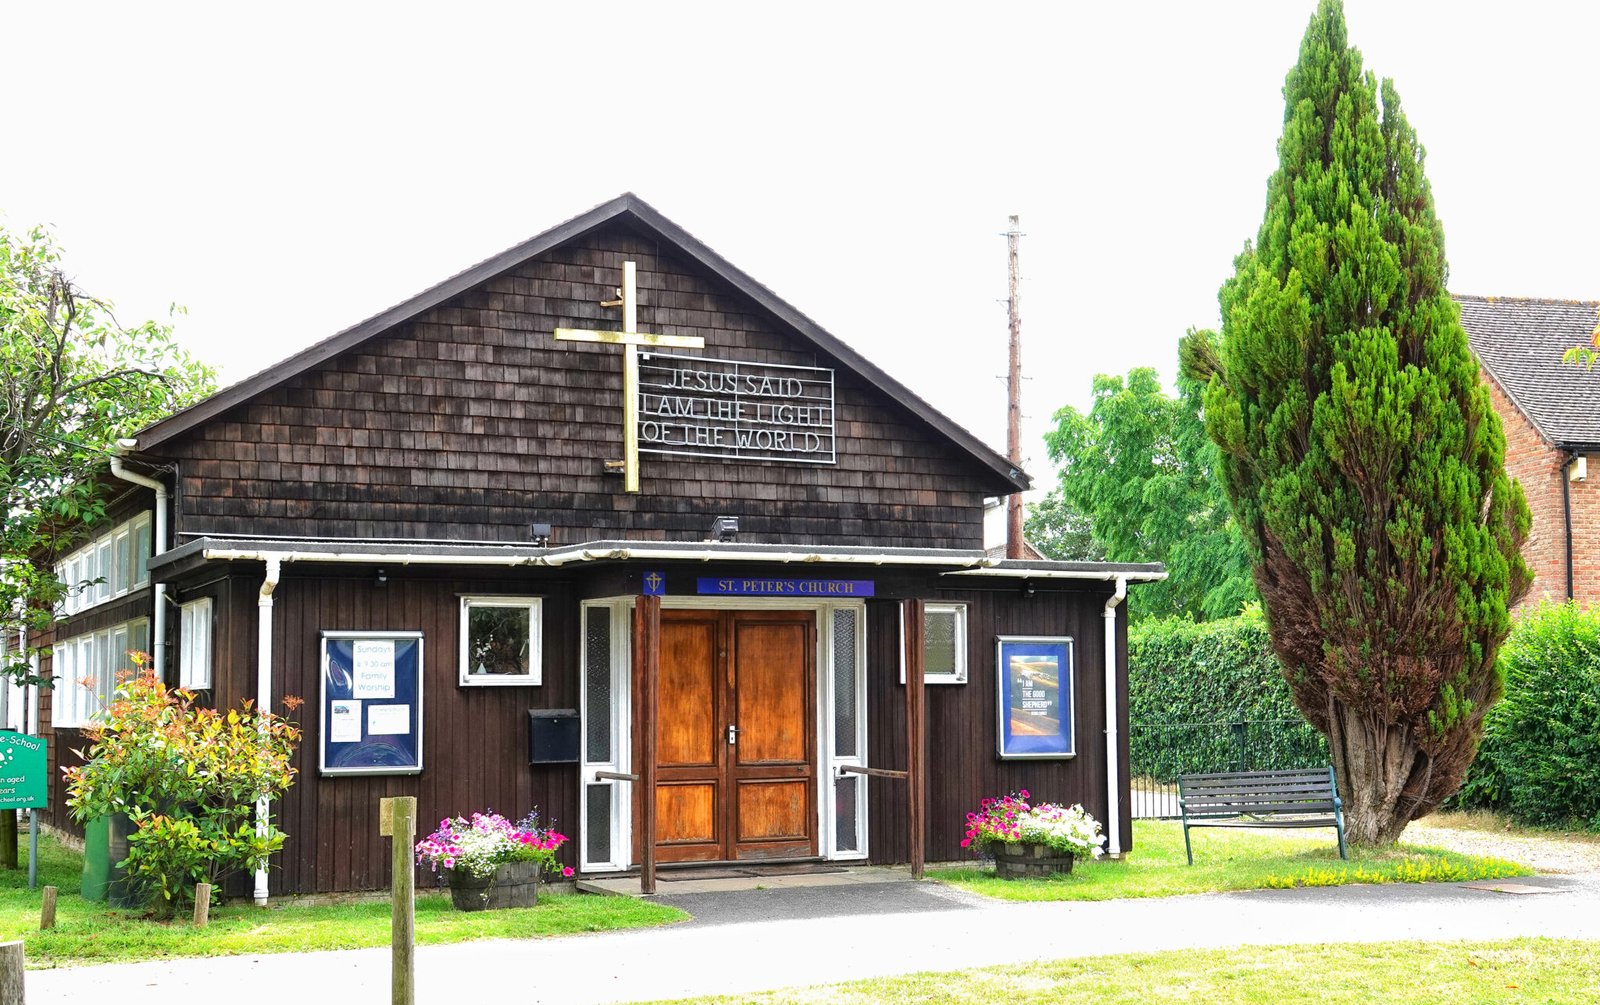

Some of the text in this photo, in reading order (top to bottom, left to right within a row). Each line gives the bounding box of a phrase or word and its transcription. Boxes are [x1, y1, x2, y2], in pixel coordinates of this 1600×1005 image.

[668, 369, 802, 398] JESUS SAID
[642, 394, 829, 427] I AM THE LIGHT
[642, 420, 820, 453] OF THE WORLD
[719, 580, 854, 593] ST. PETER'S CHURCH
[361, 672, 387, 680] Family
[358, 684, 391, 692] Worship
[6, 775, 25, 785] aged
